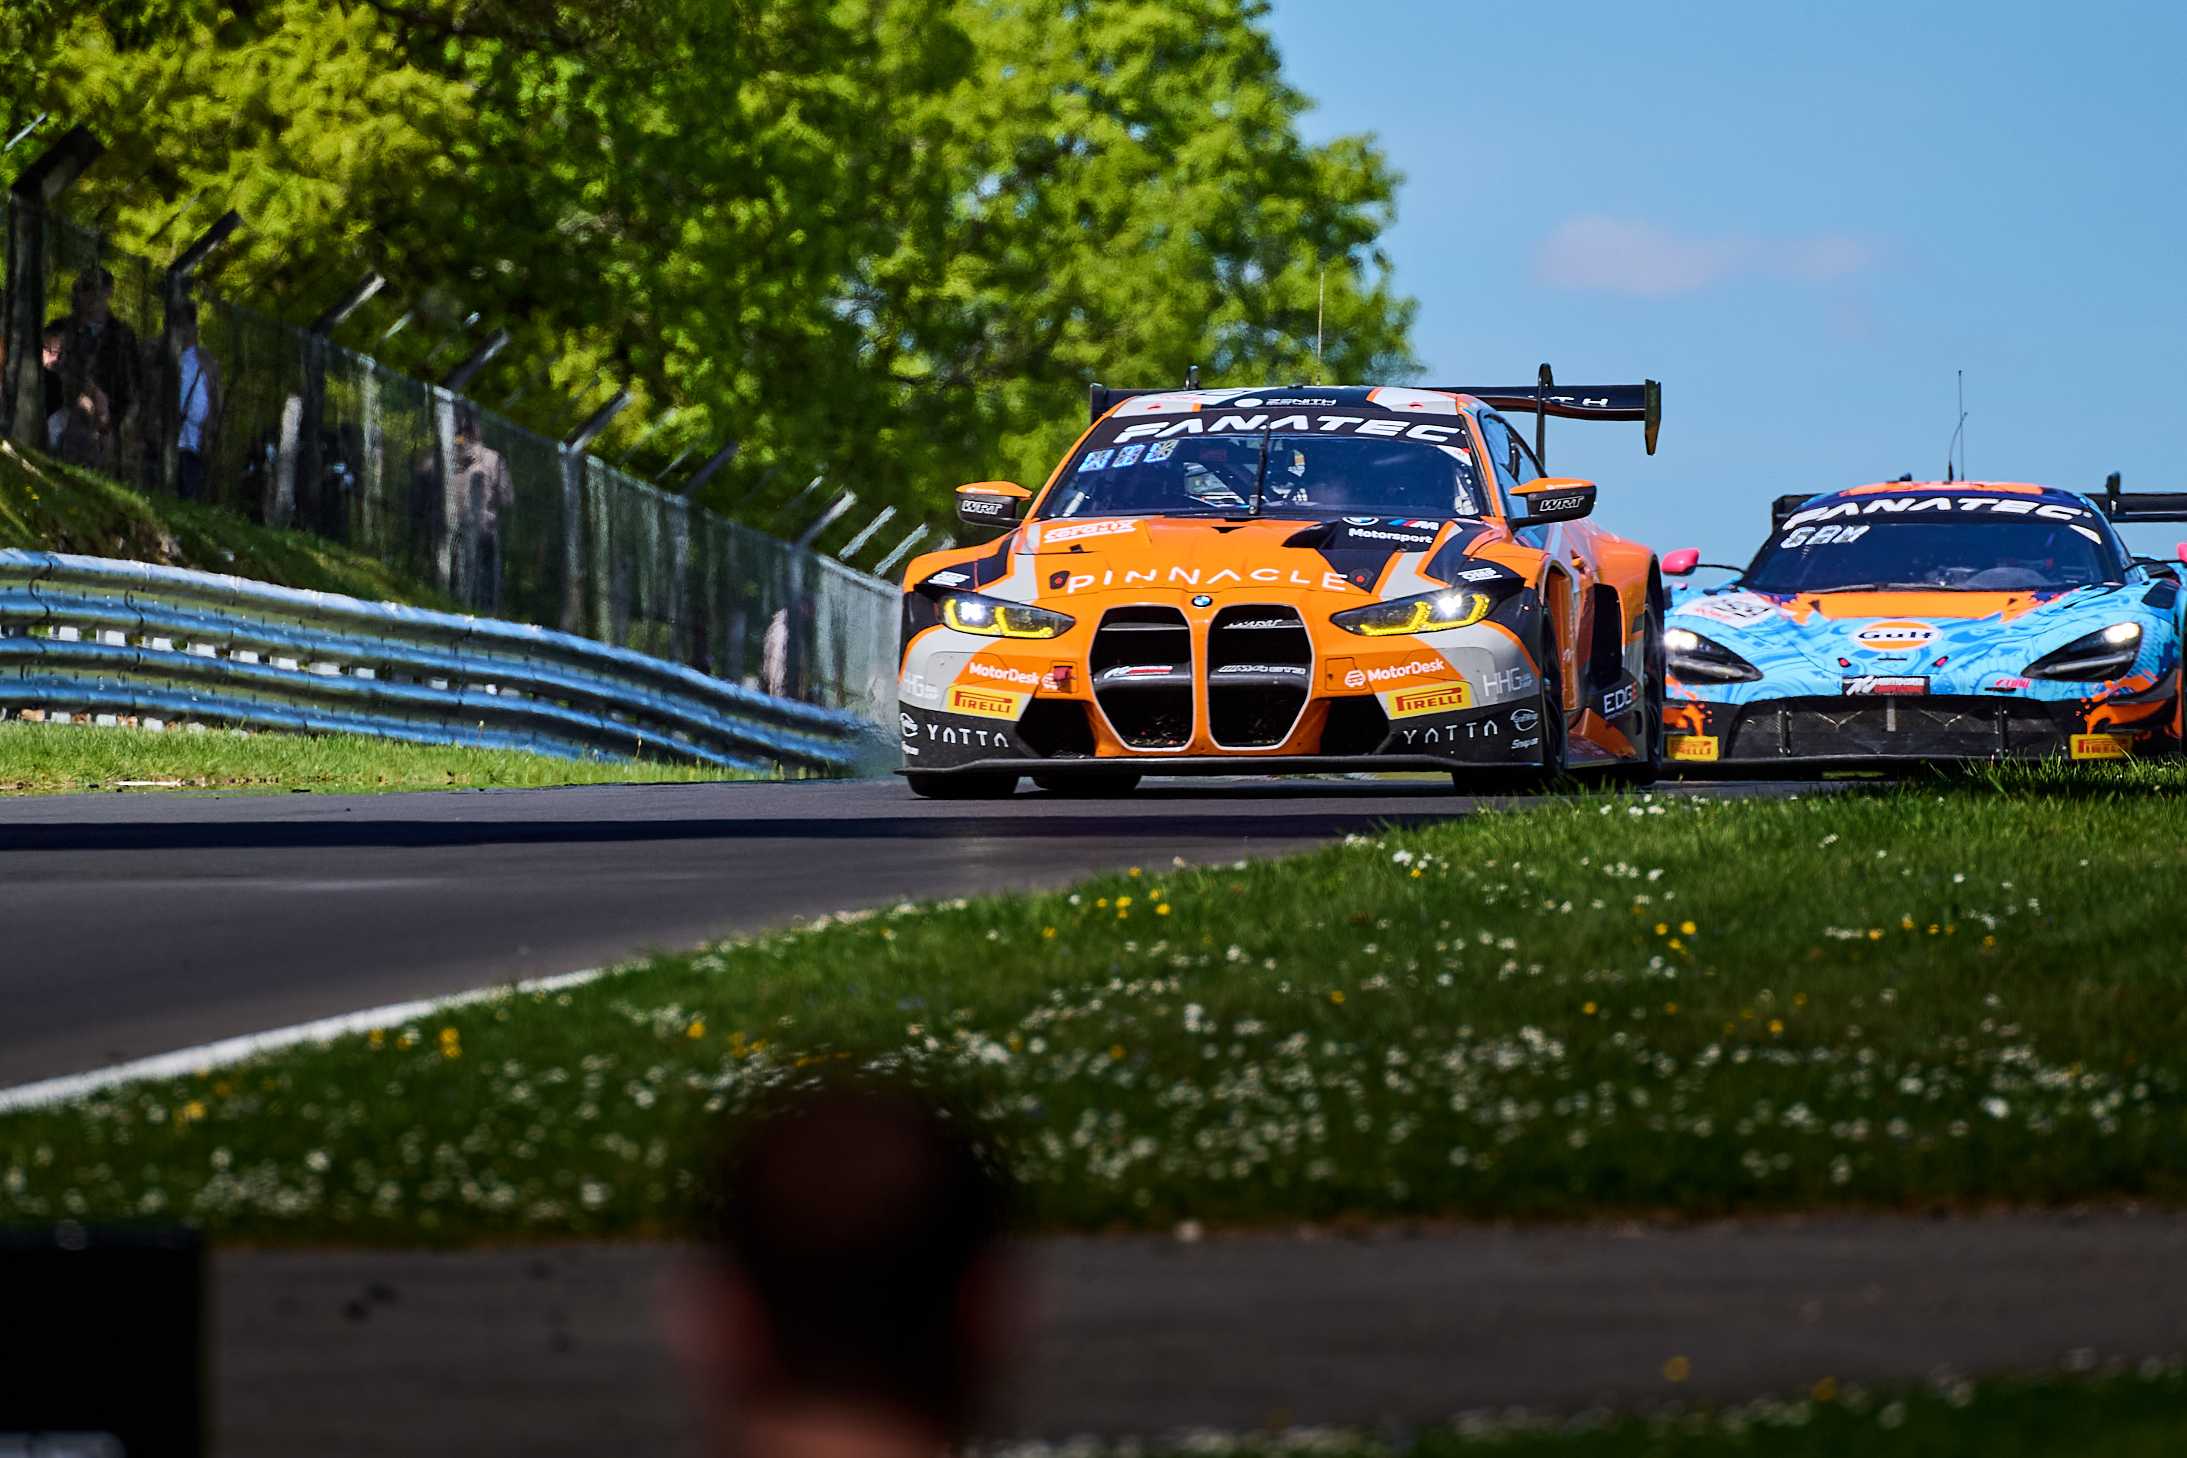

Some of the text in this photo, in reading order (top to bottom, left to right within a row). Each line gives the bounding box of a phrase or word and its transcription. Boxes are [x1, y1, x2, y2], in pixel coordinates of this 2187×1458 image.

[1113, 414, 1463, 444] FANATEC
[961, 500, 1003, 515] WRT
[1539, 496, 1585, 511] WRT
[1782, 497, 2083, 531] FANATEC
[1348, 528, 1434, 544] Motorsport
[1066, 566, 1349, 594] PINNACLE
[1858, 631, 1935, 640] Gulf
[968, 662, 1040, 685] MotorDesk
[1367, 658, 1446, 681] MotorDesk
[954, 690, 1014, 714] PIRELLI
[1395, 687, 1463, 711] PIRELLI
